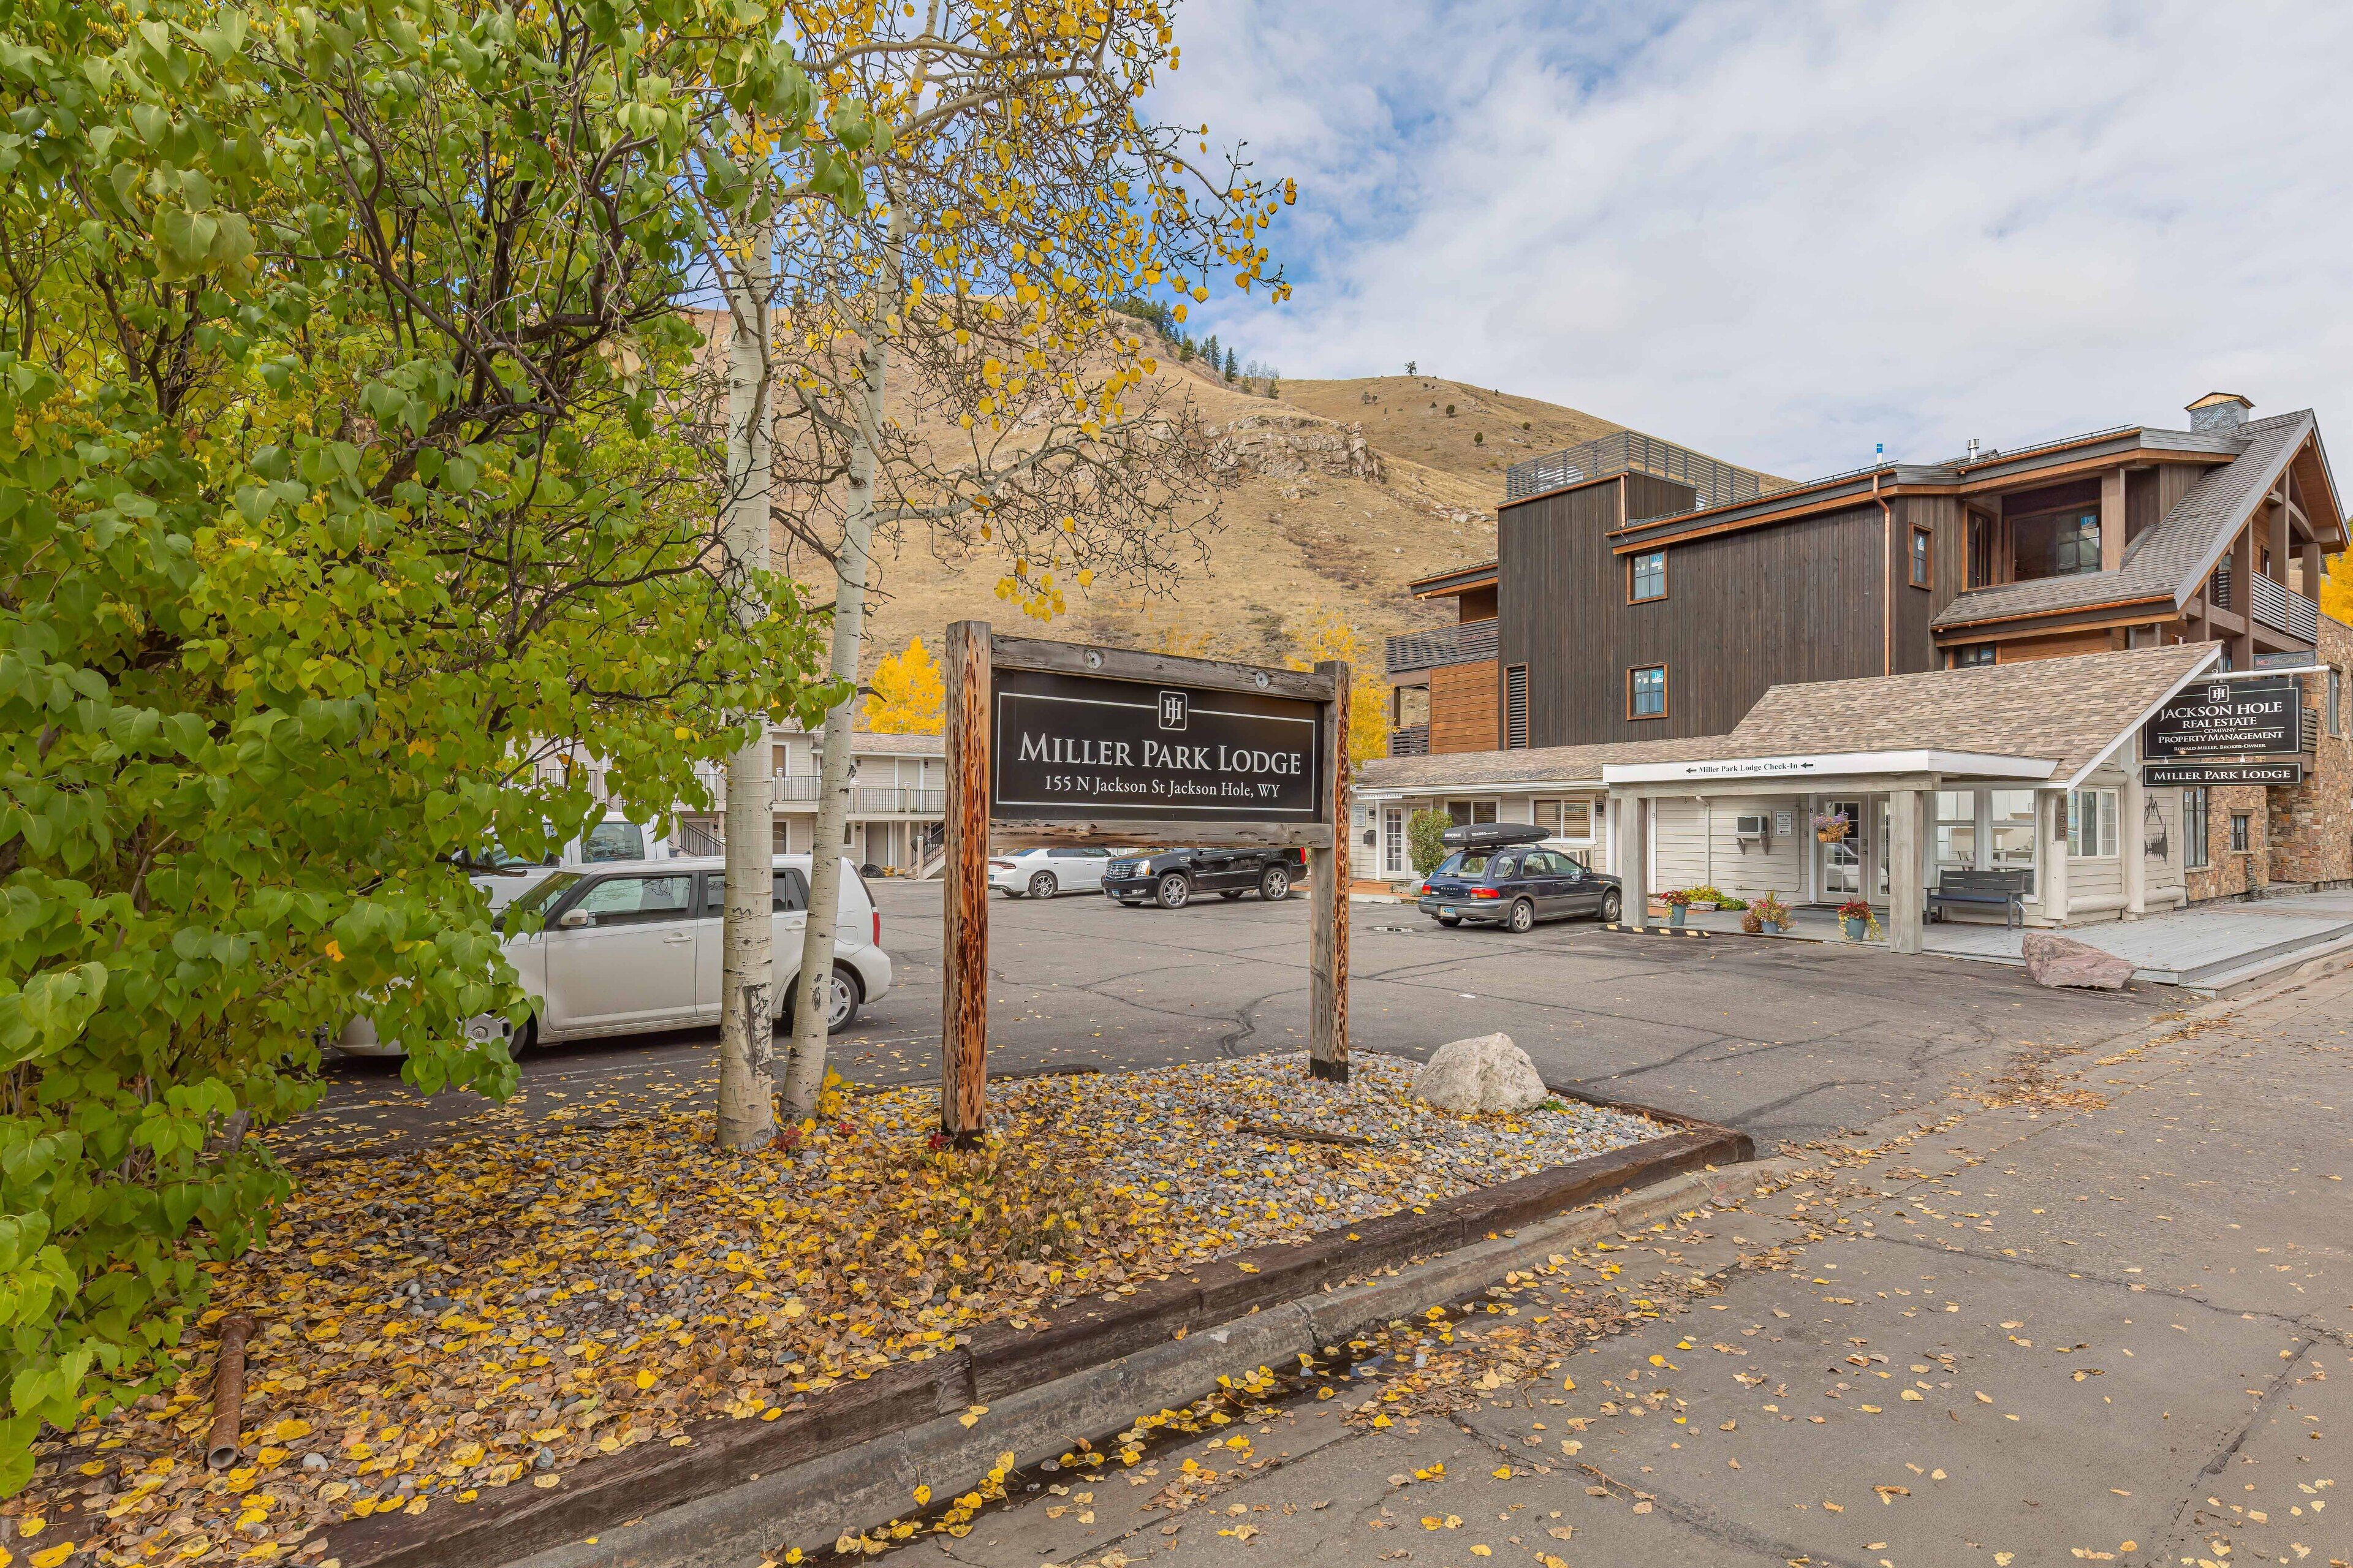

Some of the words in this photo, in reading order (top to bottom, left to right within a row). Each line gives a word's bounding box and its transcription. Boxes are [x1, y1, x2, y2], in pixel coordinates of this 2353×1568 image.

[2159, 705, 2232, 722] JACKSON
[2237, 702, 2283, 714] HOLE
[2182, 719, 2211, 729] REAL
[2214, 717, 2257, 727] ESTATE
[2208, 732, 2284, 741] MANAGEMENT
[1018, 732, 1135, 767] MILLER
[1142, 740, 1212, 770] PARK
[1218, 745, 1301, 775] LODGE
[1740, 764, 1762, 773] Lodge
[2154, 771, 2202, 781] MILLER
[2205, 770, 2239, 779] PARK
[2241, 770, 2290, 779] LODGE
[1045, 775, 1071, 791] 155
[1077, 776, 1090, 790] N
[1093, 777, 1147, 795] Jackson
[1151, 779, 1165, 793] St
[1167, 780, 1217, 797] Jackson
[1221, 782, 1254, 798] Hole,
[1257, 784, 1280, 797] WY
